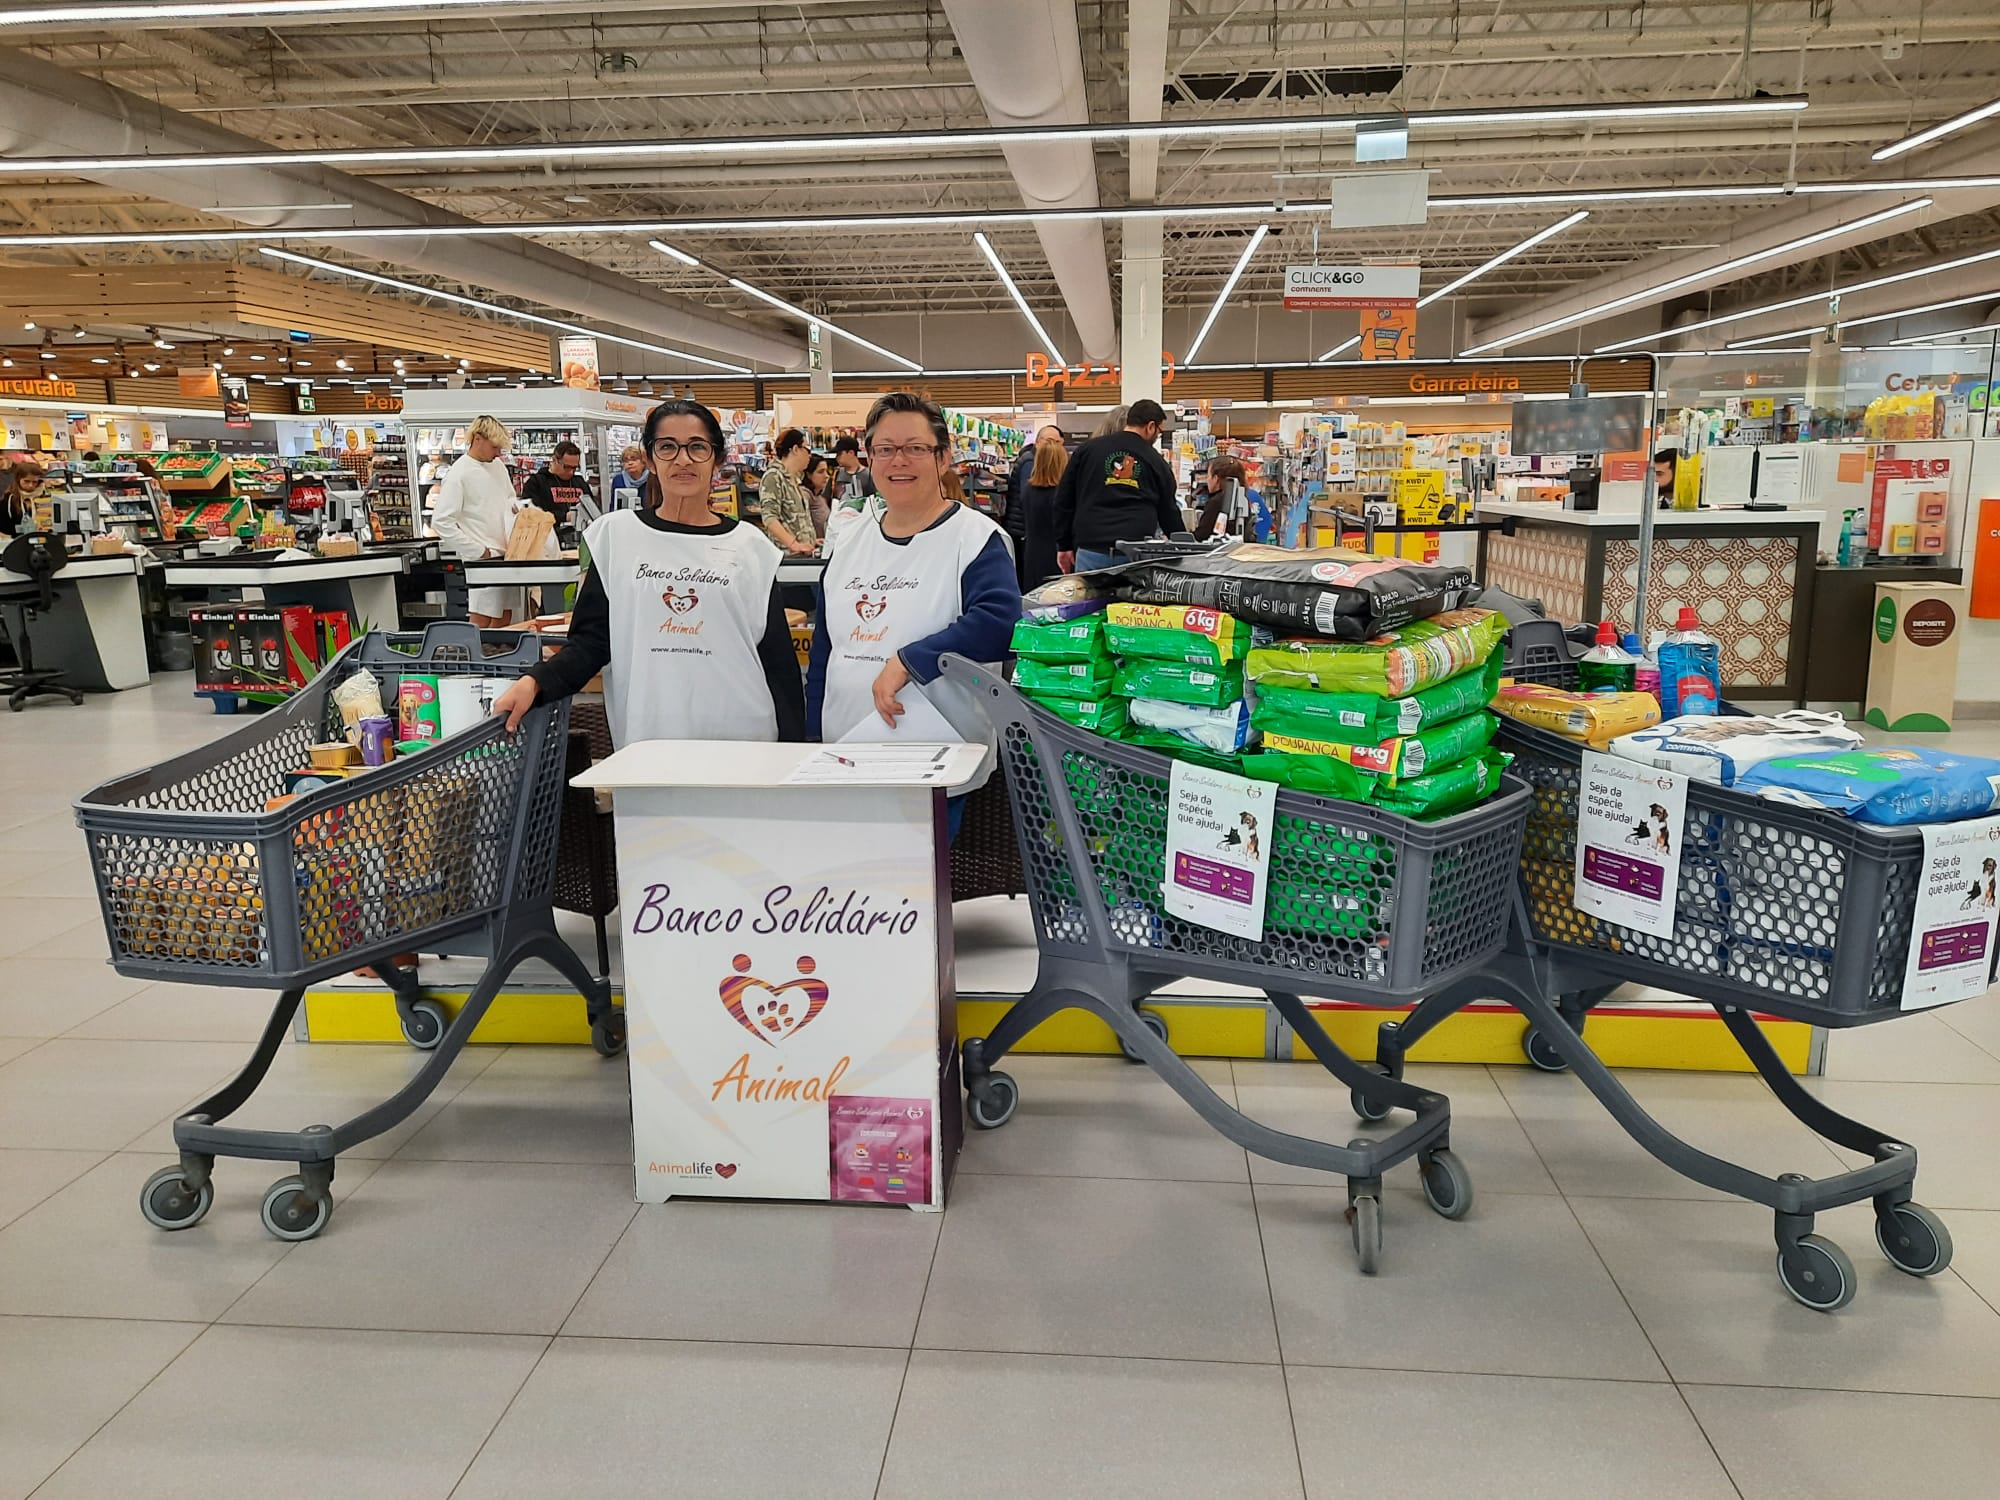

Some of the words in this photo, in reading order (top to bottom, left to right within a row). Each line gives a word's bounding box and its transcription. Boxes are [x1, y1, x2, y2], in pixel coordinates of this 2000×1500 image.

[1292, 271, 1364, 284] CLICK&GO
[1409, 372, 1520, 393] Garrafeira
[1745, 376, 1752, 385] 6
[636, 563, 673, 580] Banco
[675, 567, 730, 586] Solidário
[202, 613, 234, 621] Einhell
[249, 613, 280, 621] Einhell
[659, 617, 704, 635] Animal
[850, 625, 889, 642] Animal
[1589, 781, 1608, 795] Seja
[1610, 786, 1622, 797] da
[1180, 790, 1198, 802] Seja
[1200, 794, 1212, 805] da
[1588, 794, 1623, 810] espécie
[1179, 802, 1213, 817] espécie
[1587, 806, 1603, 817] que
[1605, 810, 1633, 824] ajuda!
[1177, 814, 1194, 825] que
[1195, 817, 1224, 832] ajuda!
[1932, 857, 1949, 869] Seja
[1951, 855, 1961, 866] da
[1928, 885, 1943, 897] que
[1944, 880, 1968, 894] ajuda!
[633, 884, 743, 935] Banco
[752, 885, 919, 935] Solidário
[712, 1053, 850, 1103] Animal
[649, 1161, 713, 1175] Animalife
